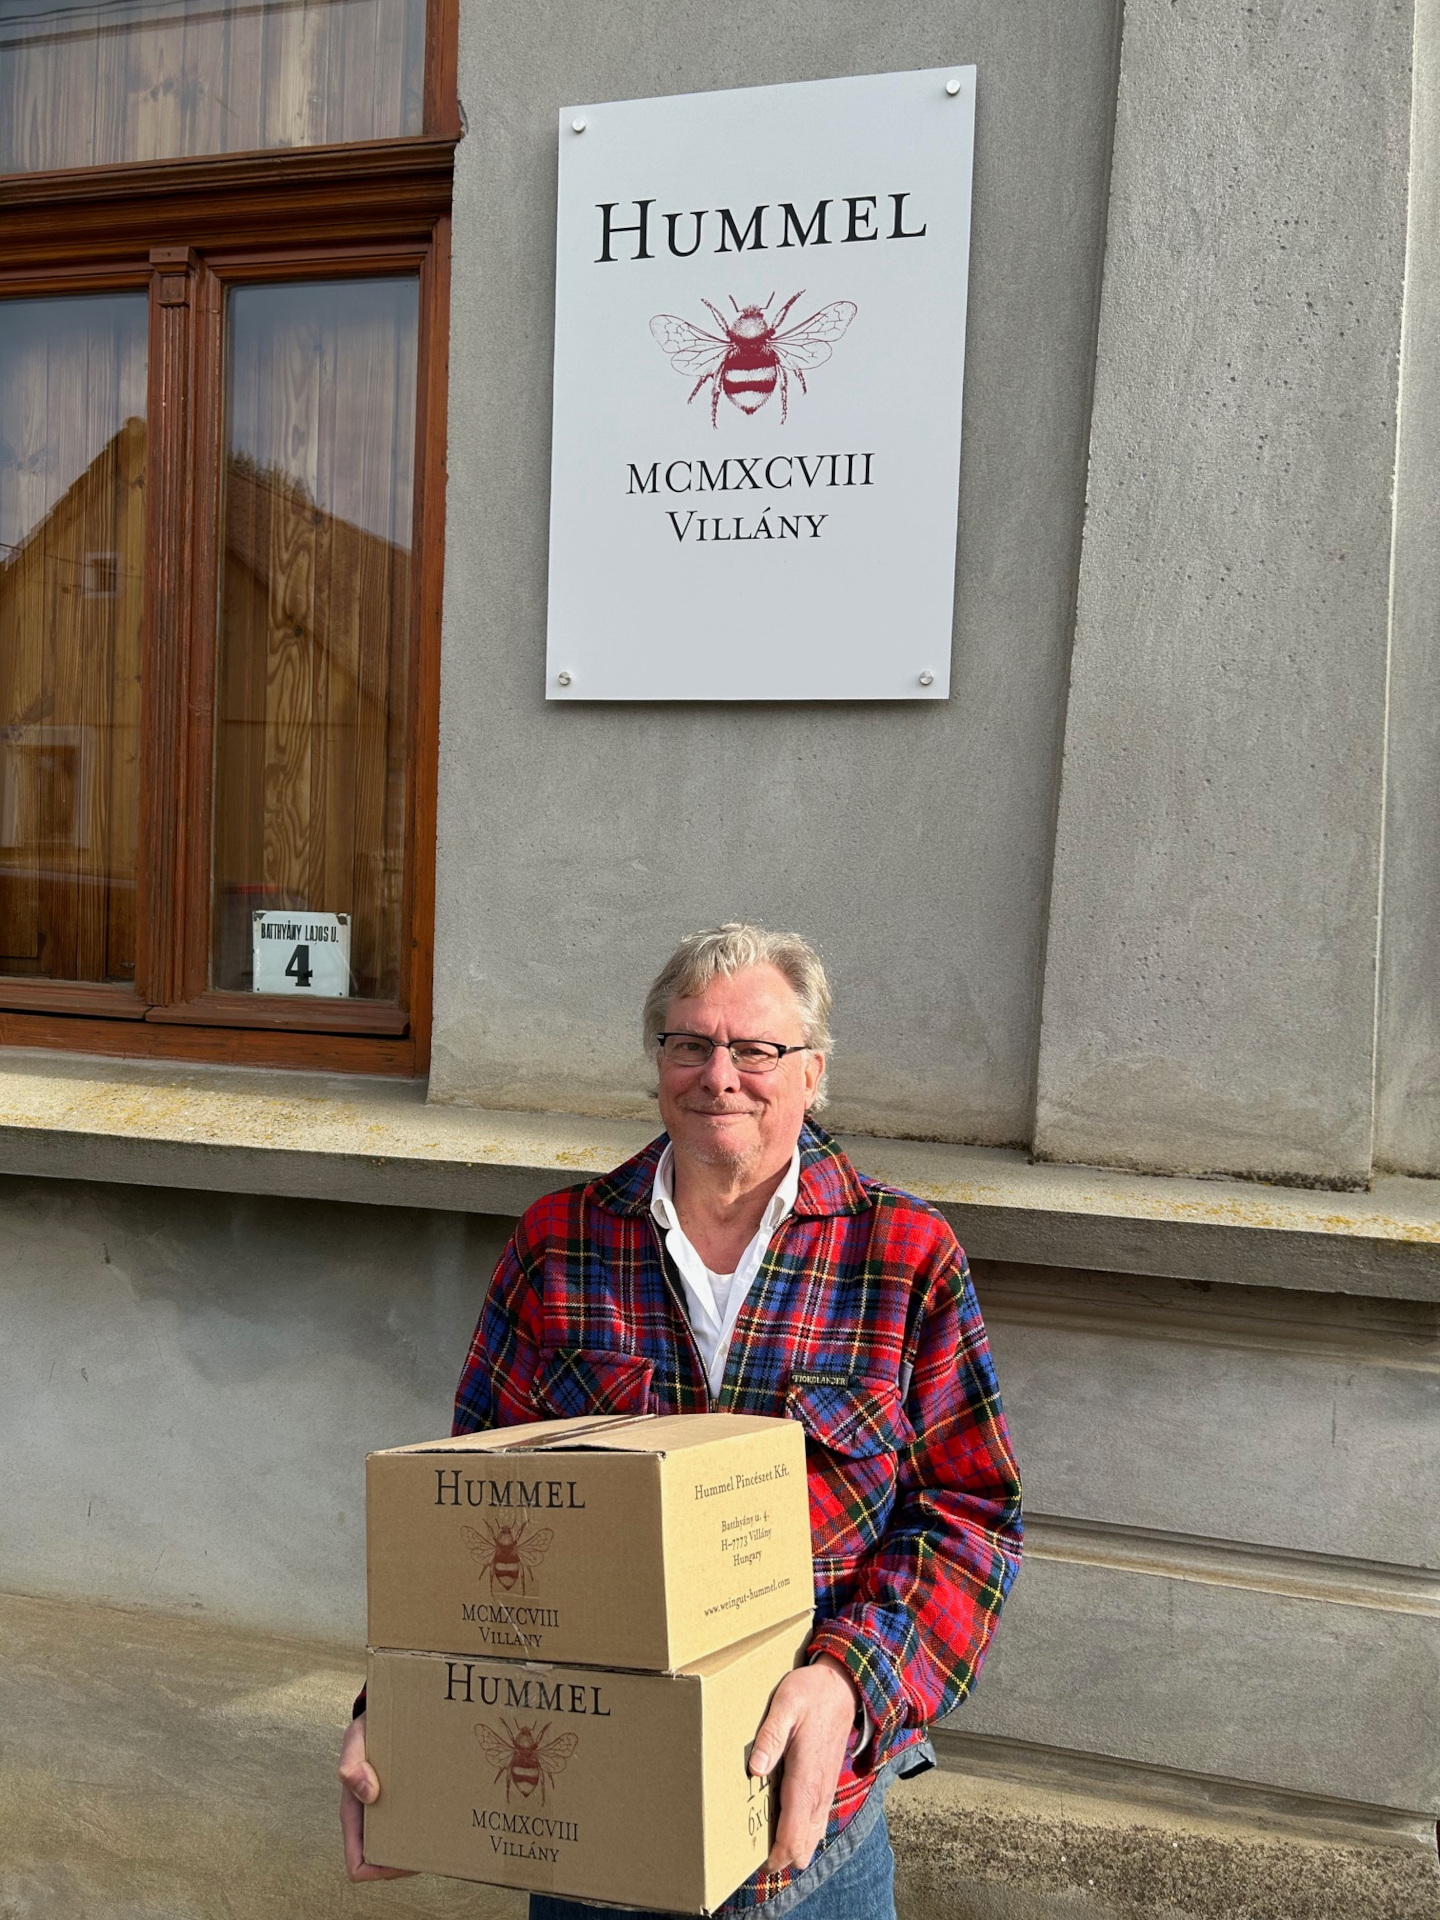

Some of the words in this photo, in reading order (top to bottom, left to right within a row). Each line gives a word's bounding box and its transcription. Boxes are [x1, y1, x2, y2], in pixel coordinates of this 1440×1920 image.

[594, 192, 928, 263] HUMMEL
[626, 452, 875, 494] MCMXCVIII
[665, 506, 829, 543] VILLÁNY
[261, 920, 302, 941] BATTHYÁNY
[305, 925, 329, 945] LAJOS
[331, 926, 339, 943] U.
[285, 944, 313, 987] 4
[434, 1469, 586, 1509] HUMMEL
[694, 1477, 734, 1500] Hummel
[736, 1471, 773, 1490] Pincészet
[774, 1463, 790, 1481] Kft.
[721, 1513, 754, 1533] Batthyány
[754, 1512, 762, 1522] u.
[749, 1527, 772, 1543] Villány
[733, 1549, 762, 1567] Hungary
[704, 1576, 791, 1617] www.weingut-hummel.com
[461, 1603, 560, 1628] MCMXCVIII
[478, 1625, 543, 1648] VILLÁNY
[443, 1661, 612, 1717] HUMMEL
[471, 1808, 579, 1843] MCMXCVIII
[489, 1835, 560, 1864] VILLÁNY
